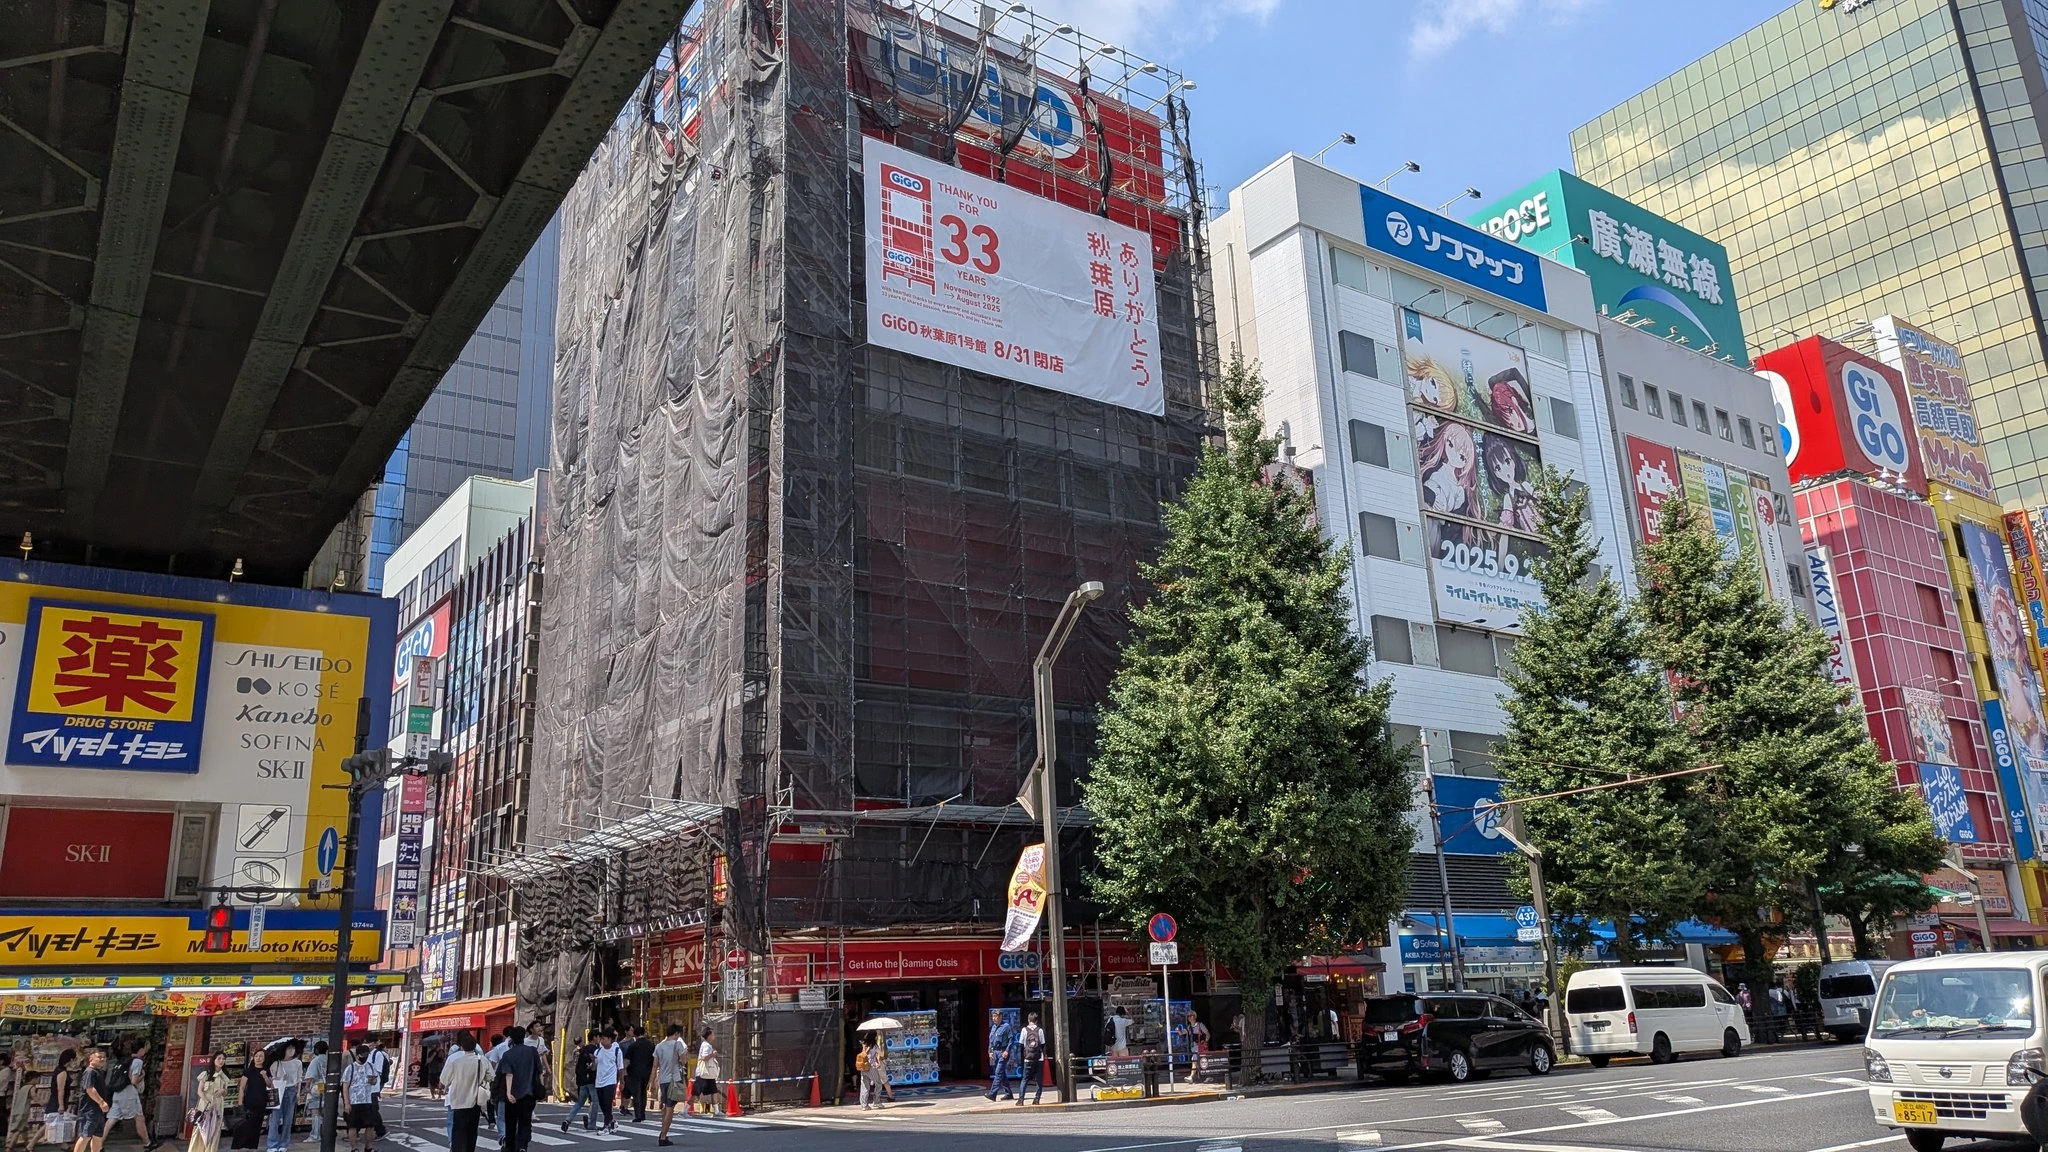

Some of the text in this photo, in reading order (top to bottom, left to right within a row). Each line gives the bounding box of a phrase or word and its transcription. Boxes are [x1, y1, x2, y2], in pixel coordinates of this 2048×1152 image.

[891, 173, 922, 191] GiGO
[938, 182, 998, 210] THANK YOU
[959, 201, 979, 216] FOR
[1480, 191, 1551, 242] ROSE
[940, 214, 1000, 275] 33
[887, 251, 913, 265] GiGO
[1417, 224, 1524, 284] ソフマップ
[957, 269, 986, 286] YEARS
[1087, 231, 1117, 320] 秋葉原
[943, 282, 1000, 304] November 1992
[956, 294, 1000, 313] August 2025
[1120, 242, 1150, 386] ありがとう
[881, 313, 918, 336] GiGO
[920, 324, 987, 354] 秋葉原1号館
[1847, 369, 1882, 418] Gi
[1913, 394, 1977, 444] 高額買取
[1857, 413, 1905, 465] GO
[1808, 555, 1836, 614] AKKY
[53, 617, 183, 714] 薬
[225, 650, 352, 674] SHISEIDO
[278, 681, 339, 699] KOSÉ
[64, 716, 154, 731] DRUG STORE
[235, 705, 333, 727] Kanebo
[22, 728, 188, 764] マツモトキヨシ
[241, 733, 325, 752] SOFINA
[1992, 728, 2012, 768] GiGO
[402, 814, 422, 823] HB
[401, 825, 421, 834] ST
[65, 844, 111, 863] SK-II
[400, 842, 420, 851] カード
[399, 852, 419, 862] ゲーム
[397, 869, 417, 879] 販売
[397, 880, 416, 890] 買取
[1518, 911, 1535, 921] 437
[0, 926, 162, 958] マツモトキヨシ
[291, 939, 354, 953] KiYosi
[1420, 940, 1443, 948] Sofma
[1912, 933, 1936, 941] GiGO
[849, 958, 958, 971] Get into the Gaming Oasis
[1000, 953, 1039, 970] GiGO
[1108, 955, 1120, 964] Get
[1122, 955, 1135, 963] into
[1113, 976, 1152, 991] Grandista
[1903, 1110, 1933, 1122] 85-17
